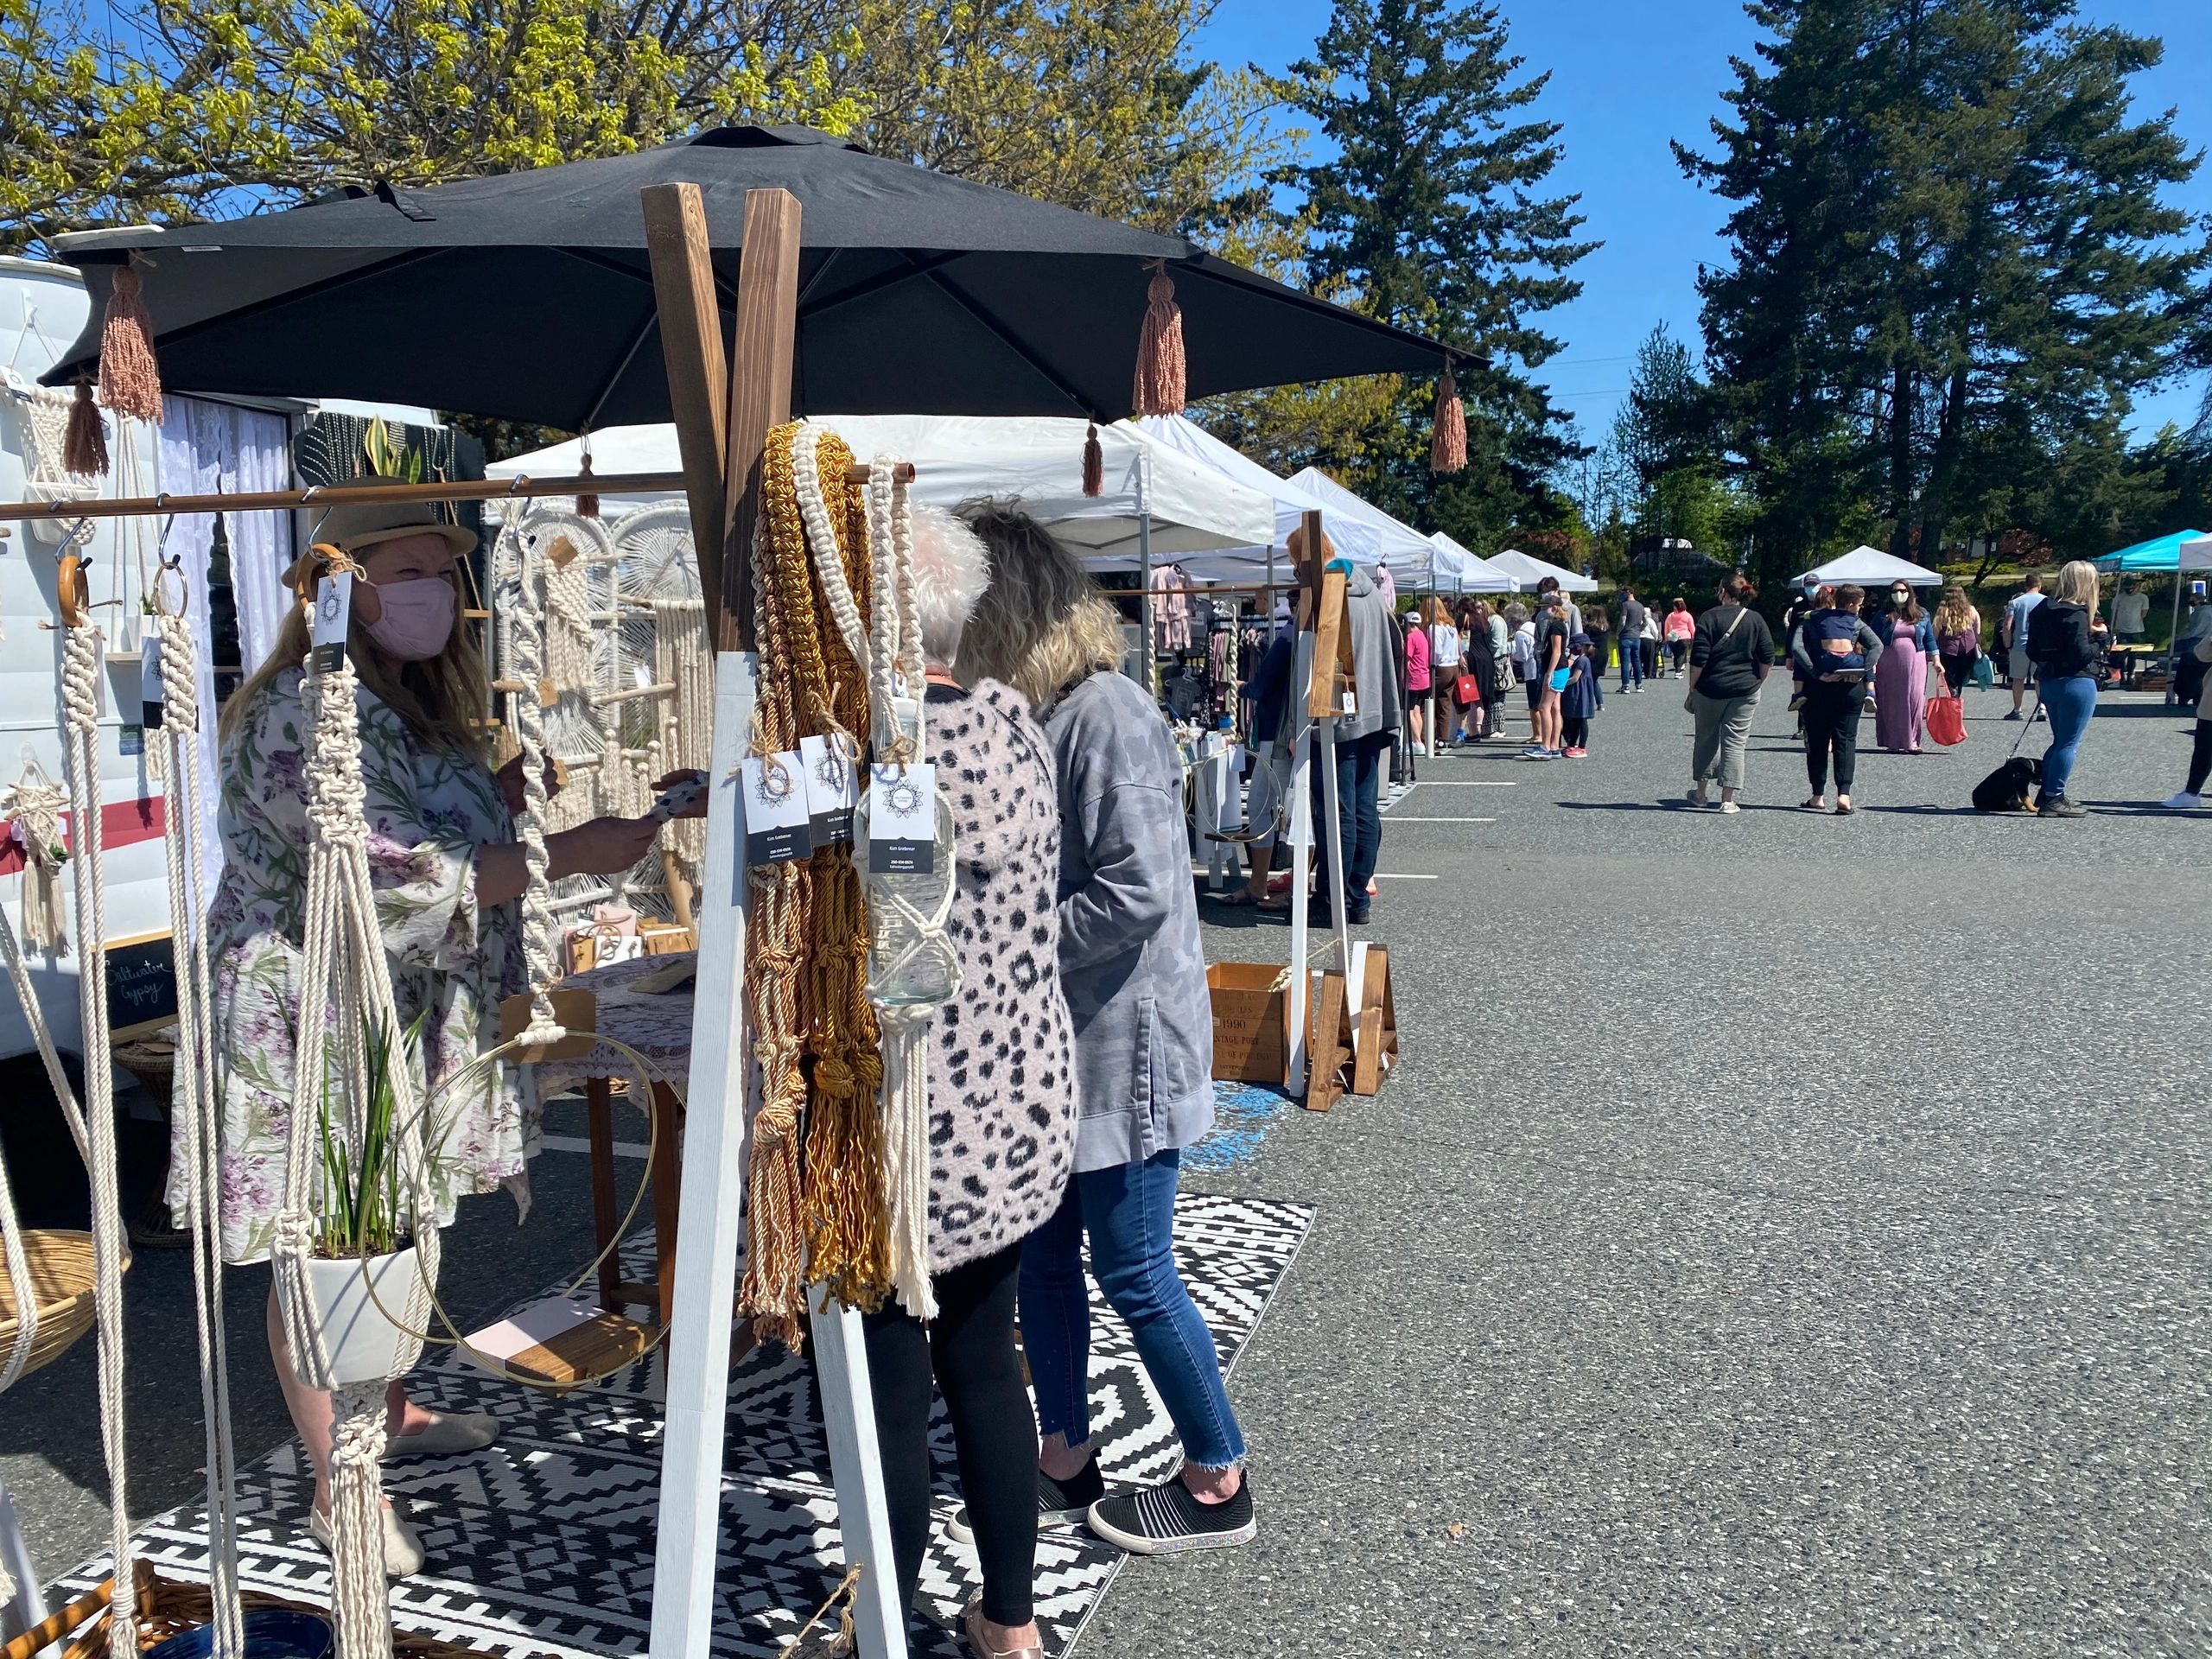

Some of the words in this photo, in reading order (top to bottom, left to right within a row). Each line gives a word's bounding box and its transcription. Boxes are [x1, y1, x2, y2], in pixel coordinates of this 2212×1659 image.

[105, 959, 173, 986] Saltwater
[122, 983, 164, 1007] Gypsy
[1223, 1019, 1246, 1030] 1990
[1215, 1036, 1238, 1045] NTAGE
